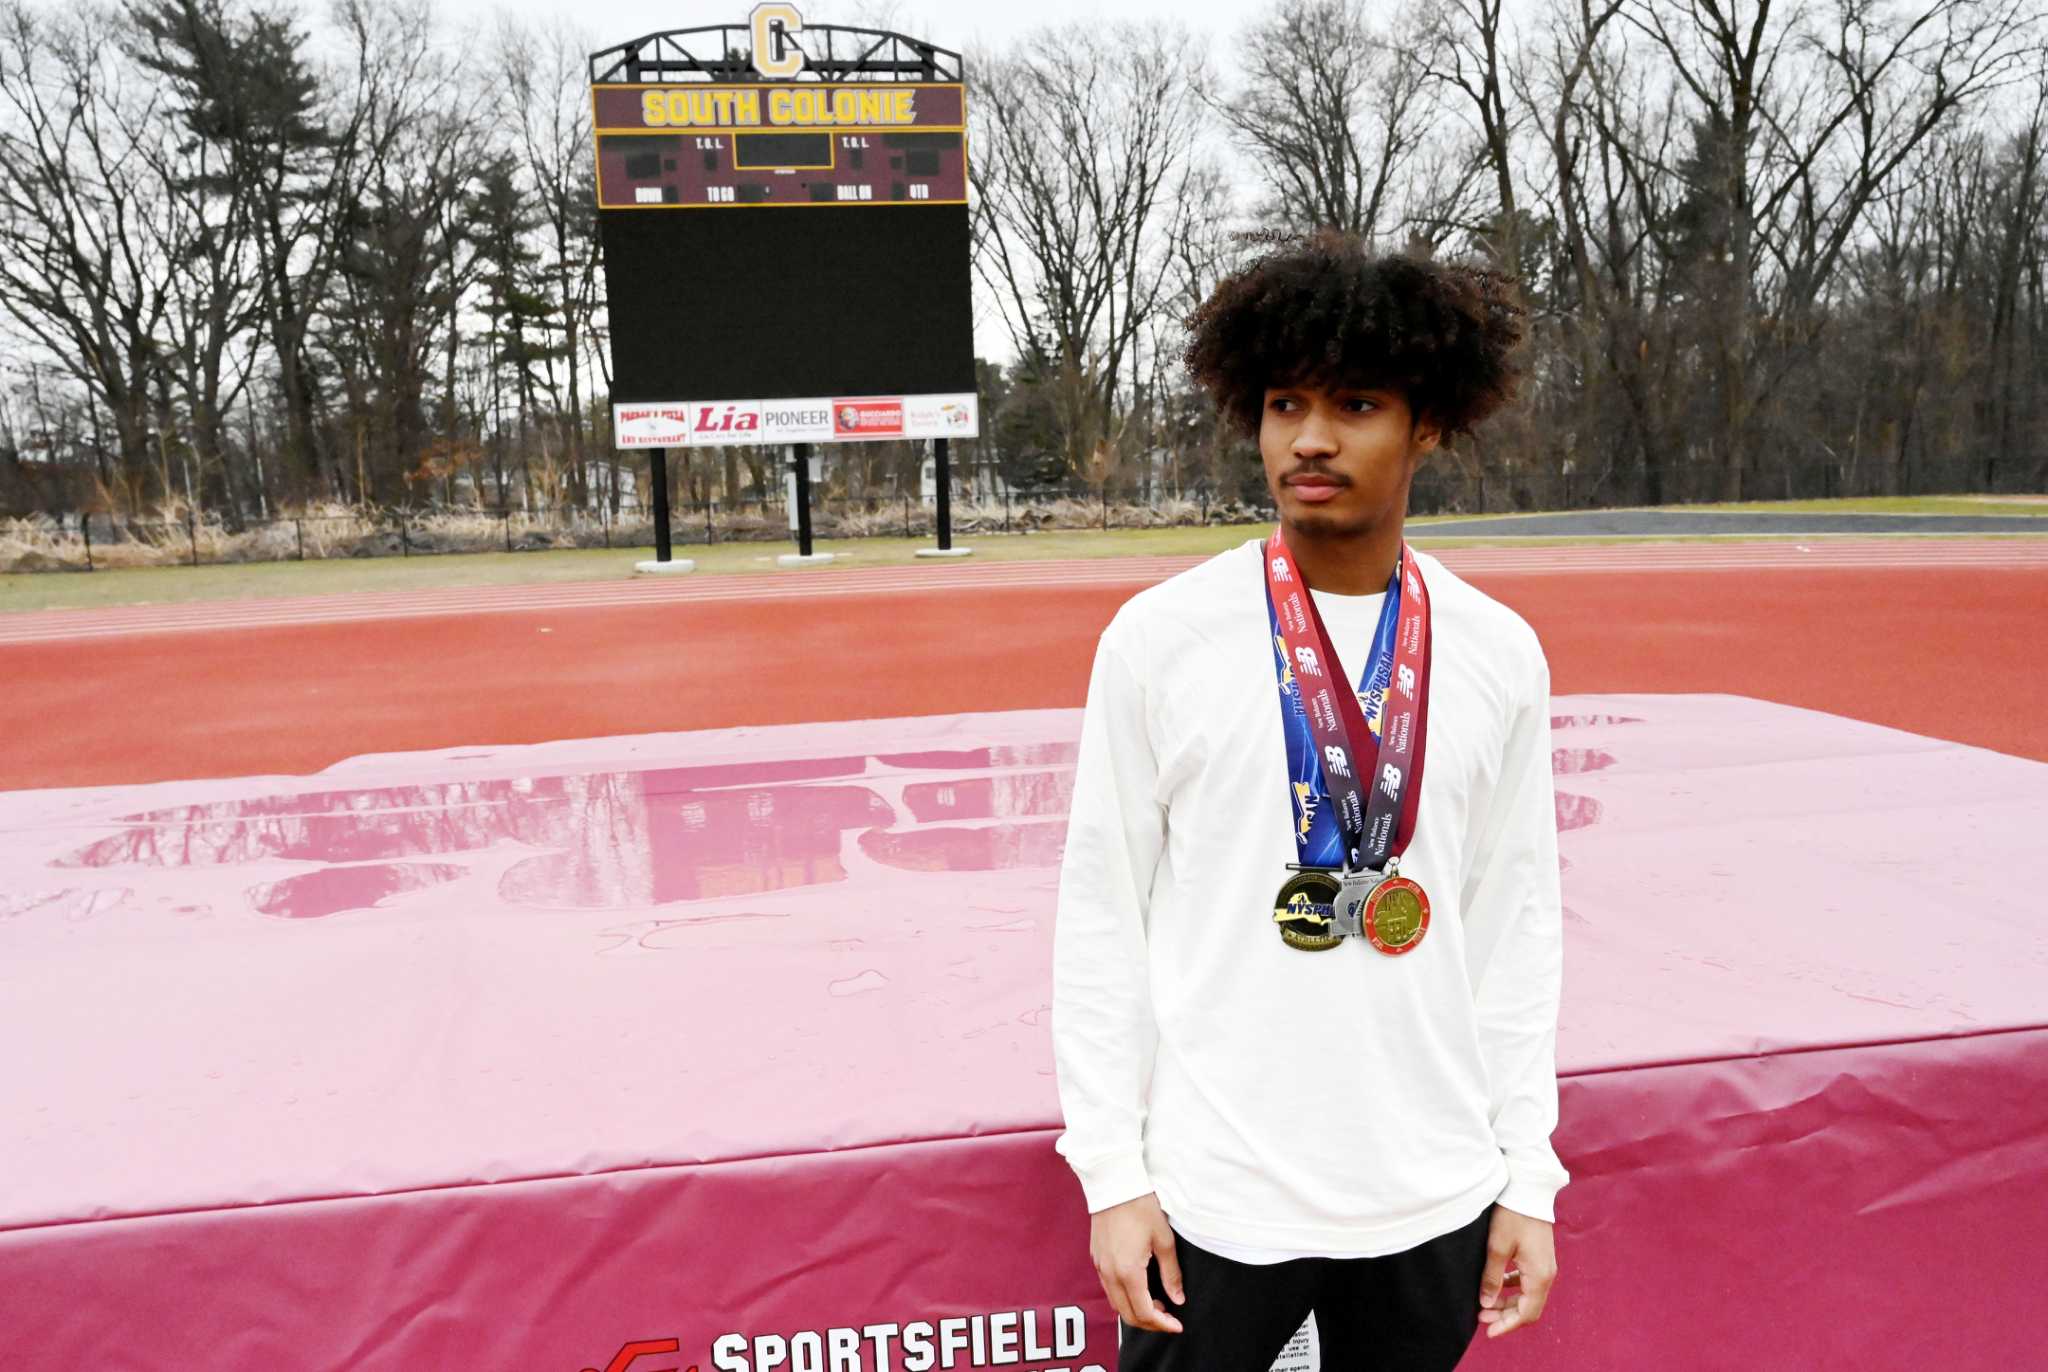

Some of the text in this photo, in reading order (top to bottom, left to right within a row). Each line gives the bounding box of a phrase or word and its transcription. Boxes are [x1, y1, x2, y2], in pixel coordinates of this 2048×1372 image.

[750, 2, 803, 78] C
[642, 88, 917, 126] SOUTH COLONIE
[694, 406, 759, 432] Lia
[765, 410, 829, 426] PIONEER
[1317, 688, 1338, 732] Nationals
[1396, 712, 1411, 754] Nationals
[1374, 813, 1393, 857] Nationals
[711, 1305, 1086, 1372] SPORTSFIELD
